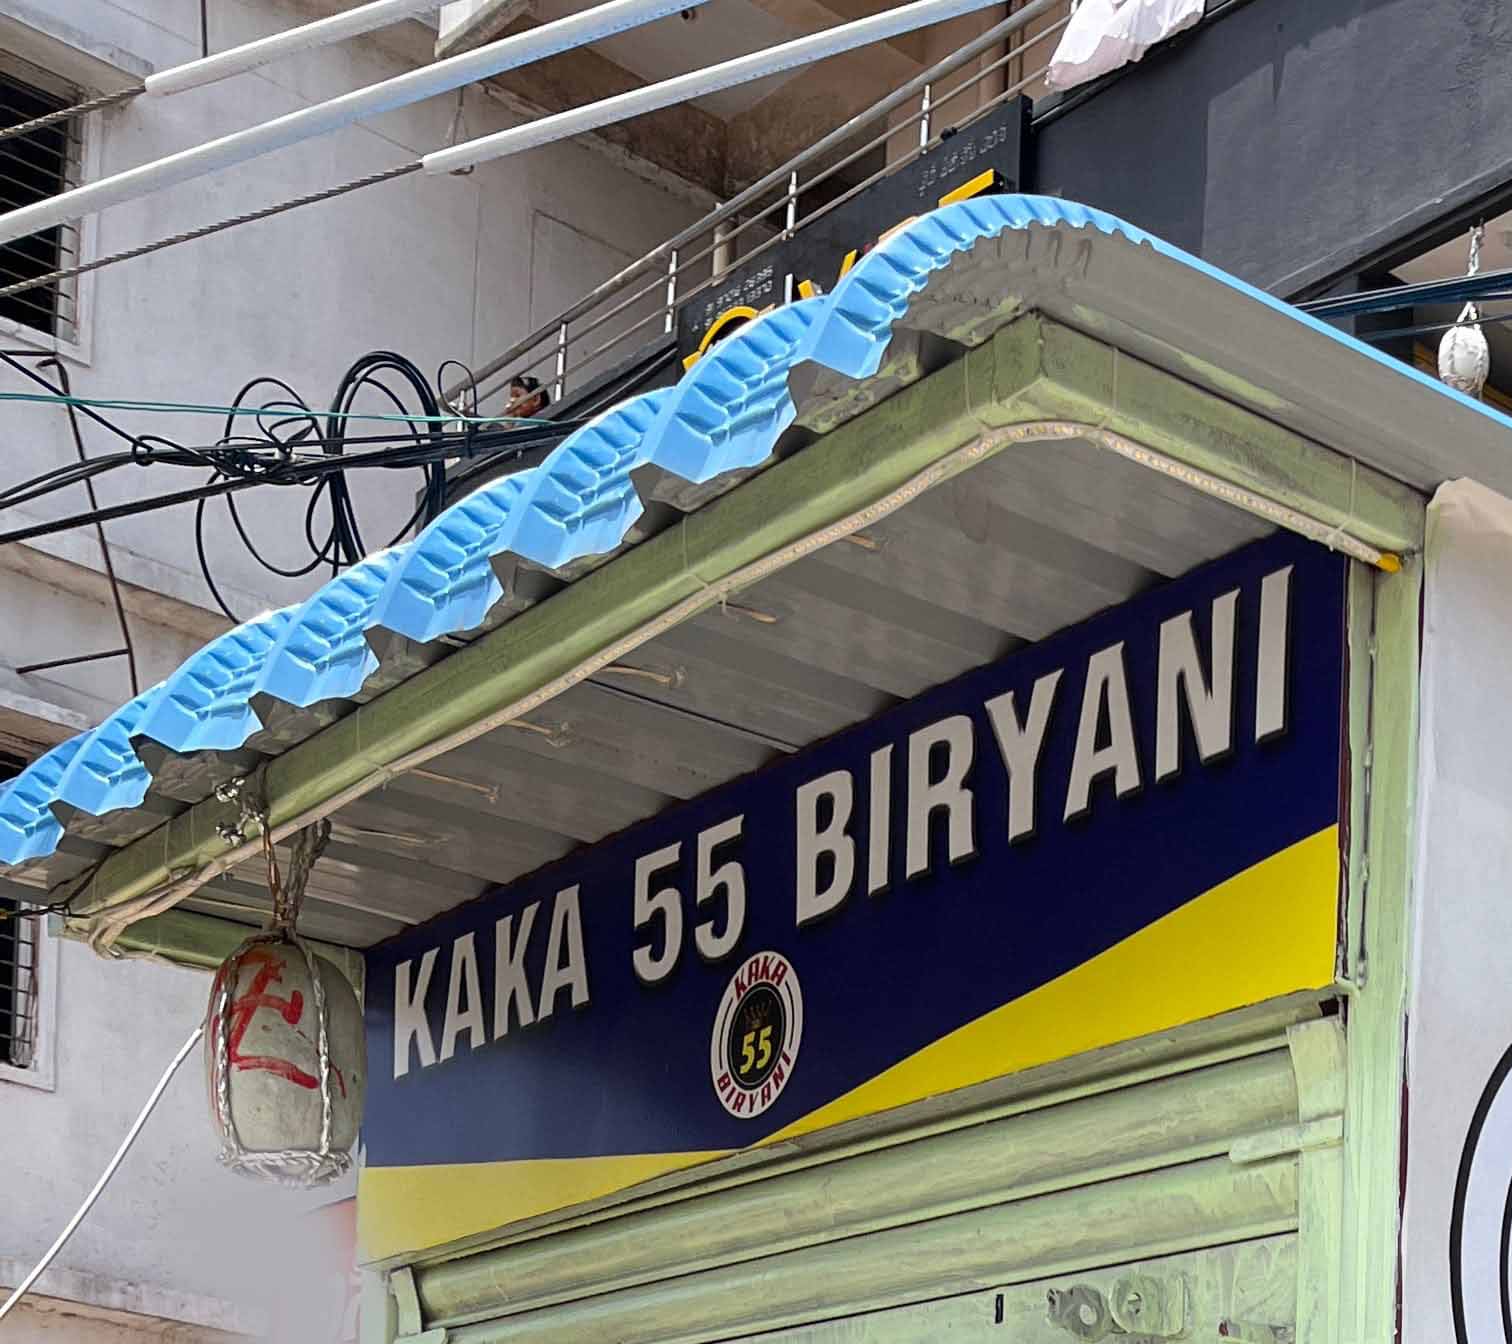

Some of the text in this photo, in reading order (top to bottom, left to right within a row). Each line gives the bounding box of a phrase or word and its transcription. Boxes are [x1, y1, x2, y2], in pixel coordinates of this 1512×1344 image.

[392, 563, 1296, 1080] KAKA 55 BIRYANI
[734, 955, 789, 1001] KAKA
[739, 1025, 773, 1074] 55
[717, 1049, 791, 1113] BIRYANI
